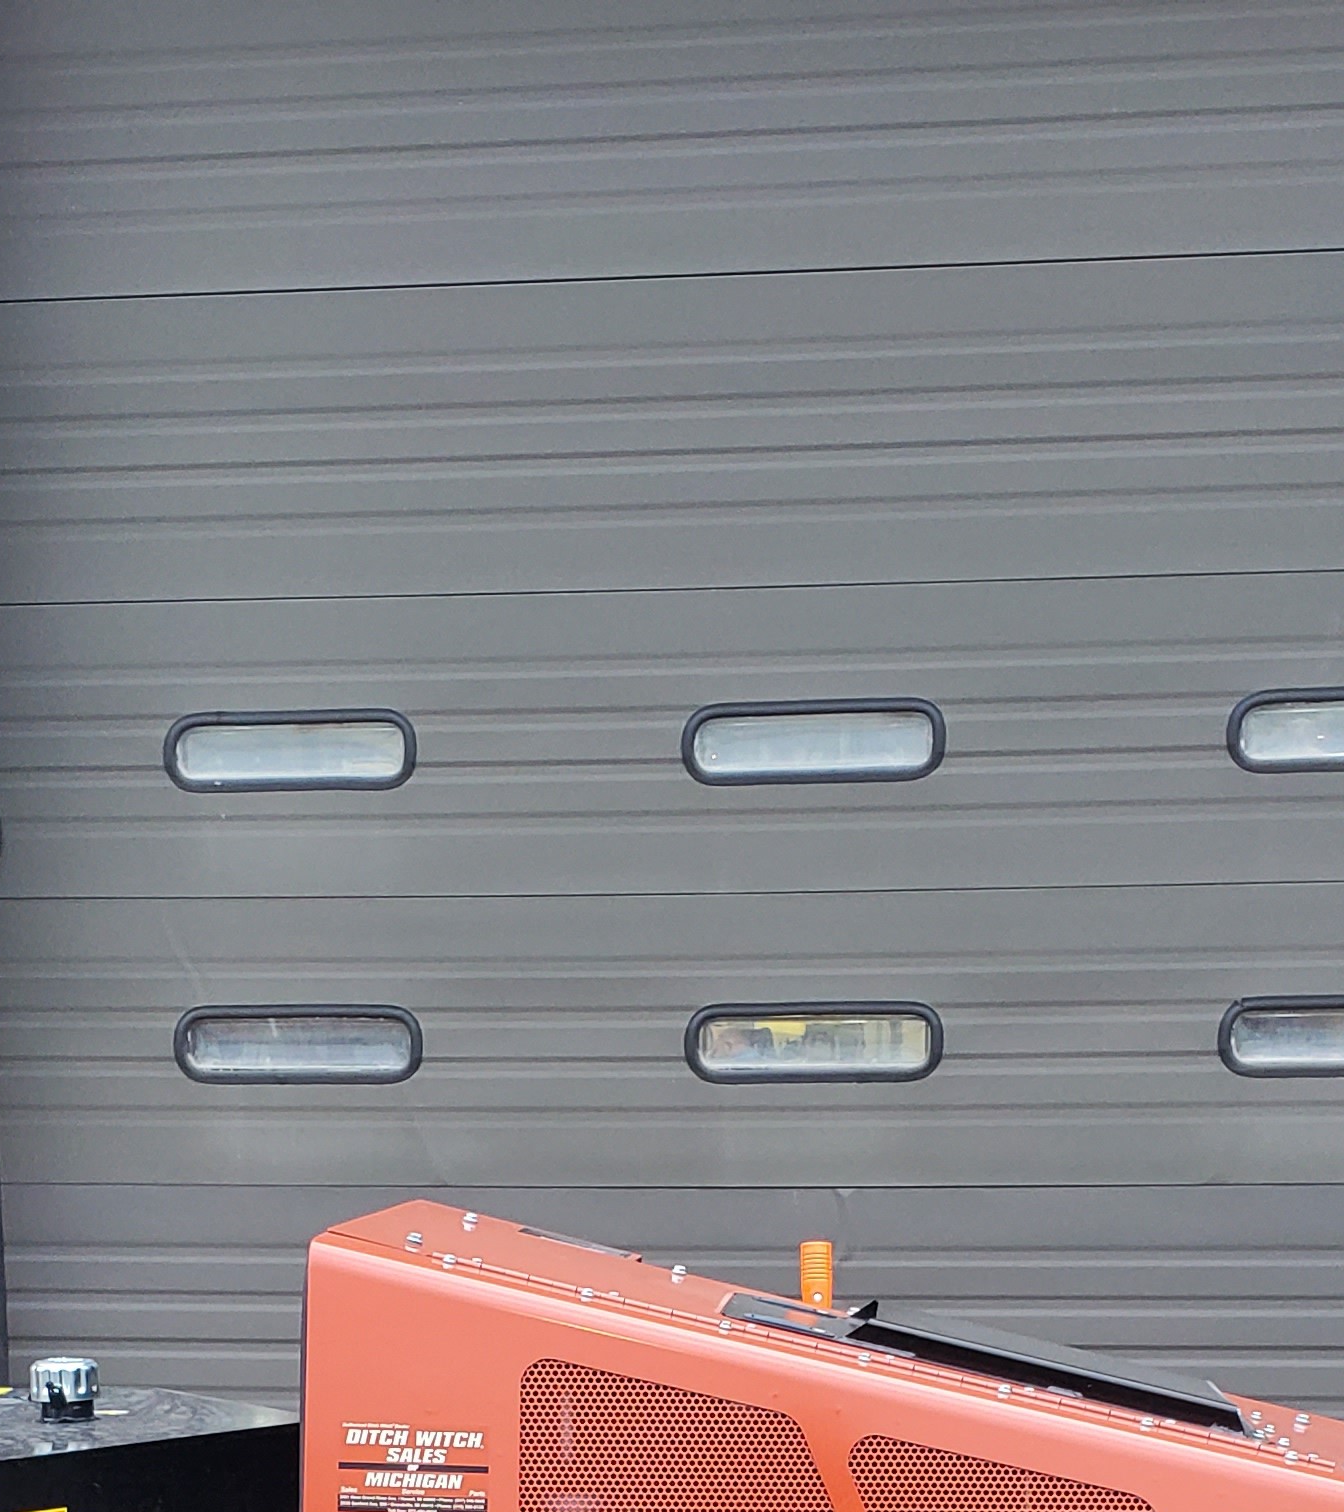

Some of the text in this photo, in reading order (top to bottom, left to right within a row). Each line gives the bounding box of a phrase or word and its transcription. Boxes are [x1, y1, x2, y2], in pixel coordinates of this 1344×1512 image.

[346, 1429, 409, 1446] DITCH
[386, 1448, 447, 1464] SALES
[365, 1472, 463, 1490] MICHIGAN
